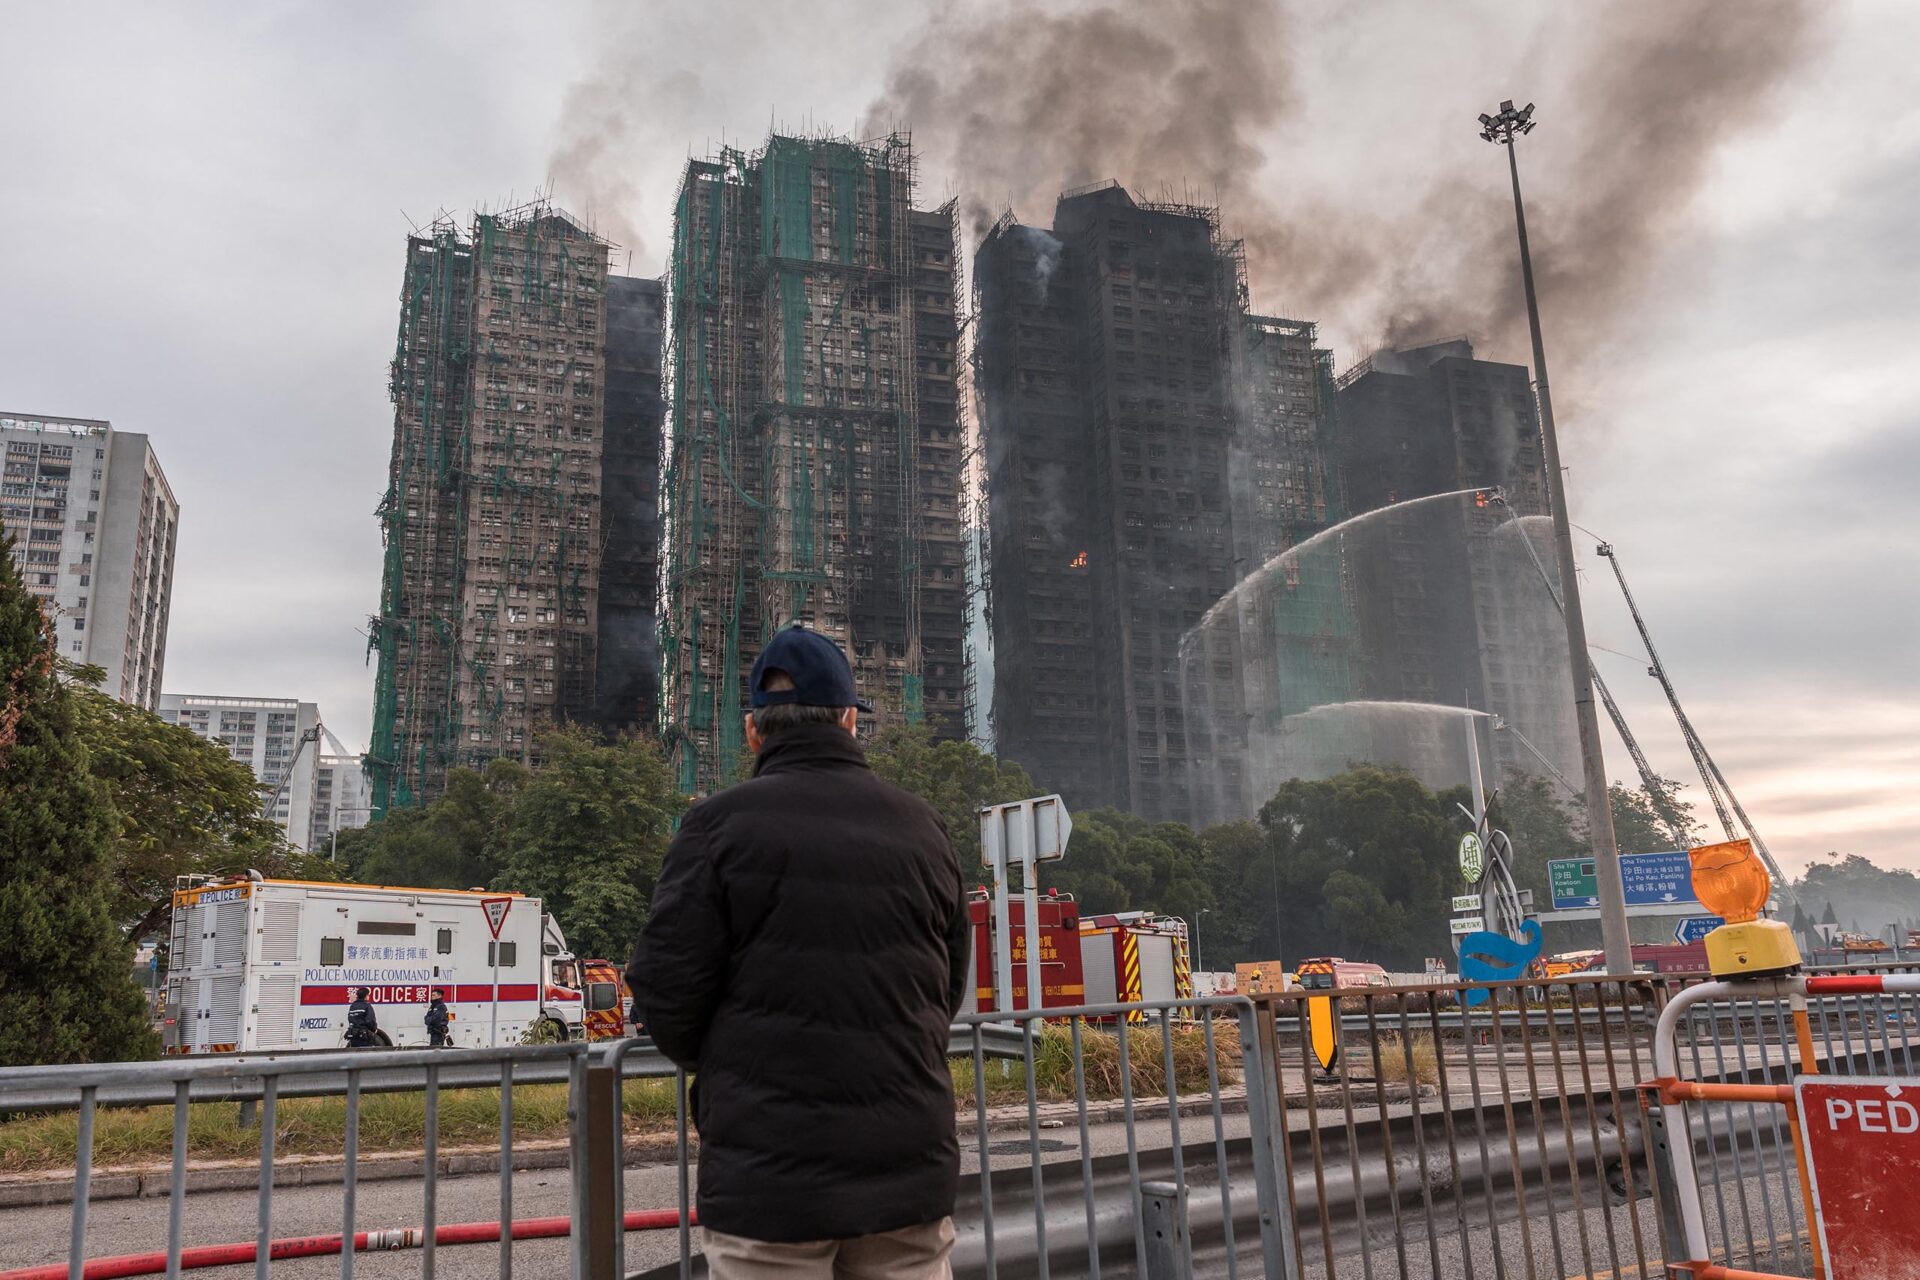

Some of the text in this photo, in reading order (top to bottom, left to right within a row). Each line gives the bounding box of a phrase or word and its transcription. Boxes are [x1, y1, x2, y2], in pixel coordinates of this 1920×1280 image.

[207, 890, 234, 902] POLICE
[347, 945, 428, 960] 警察流動指揮車
[305, 969, 453, 981] POLICE MOBILE COMMAND UNIT
[416, 987, 427, 1002] 察
